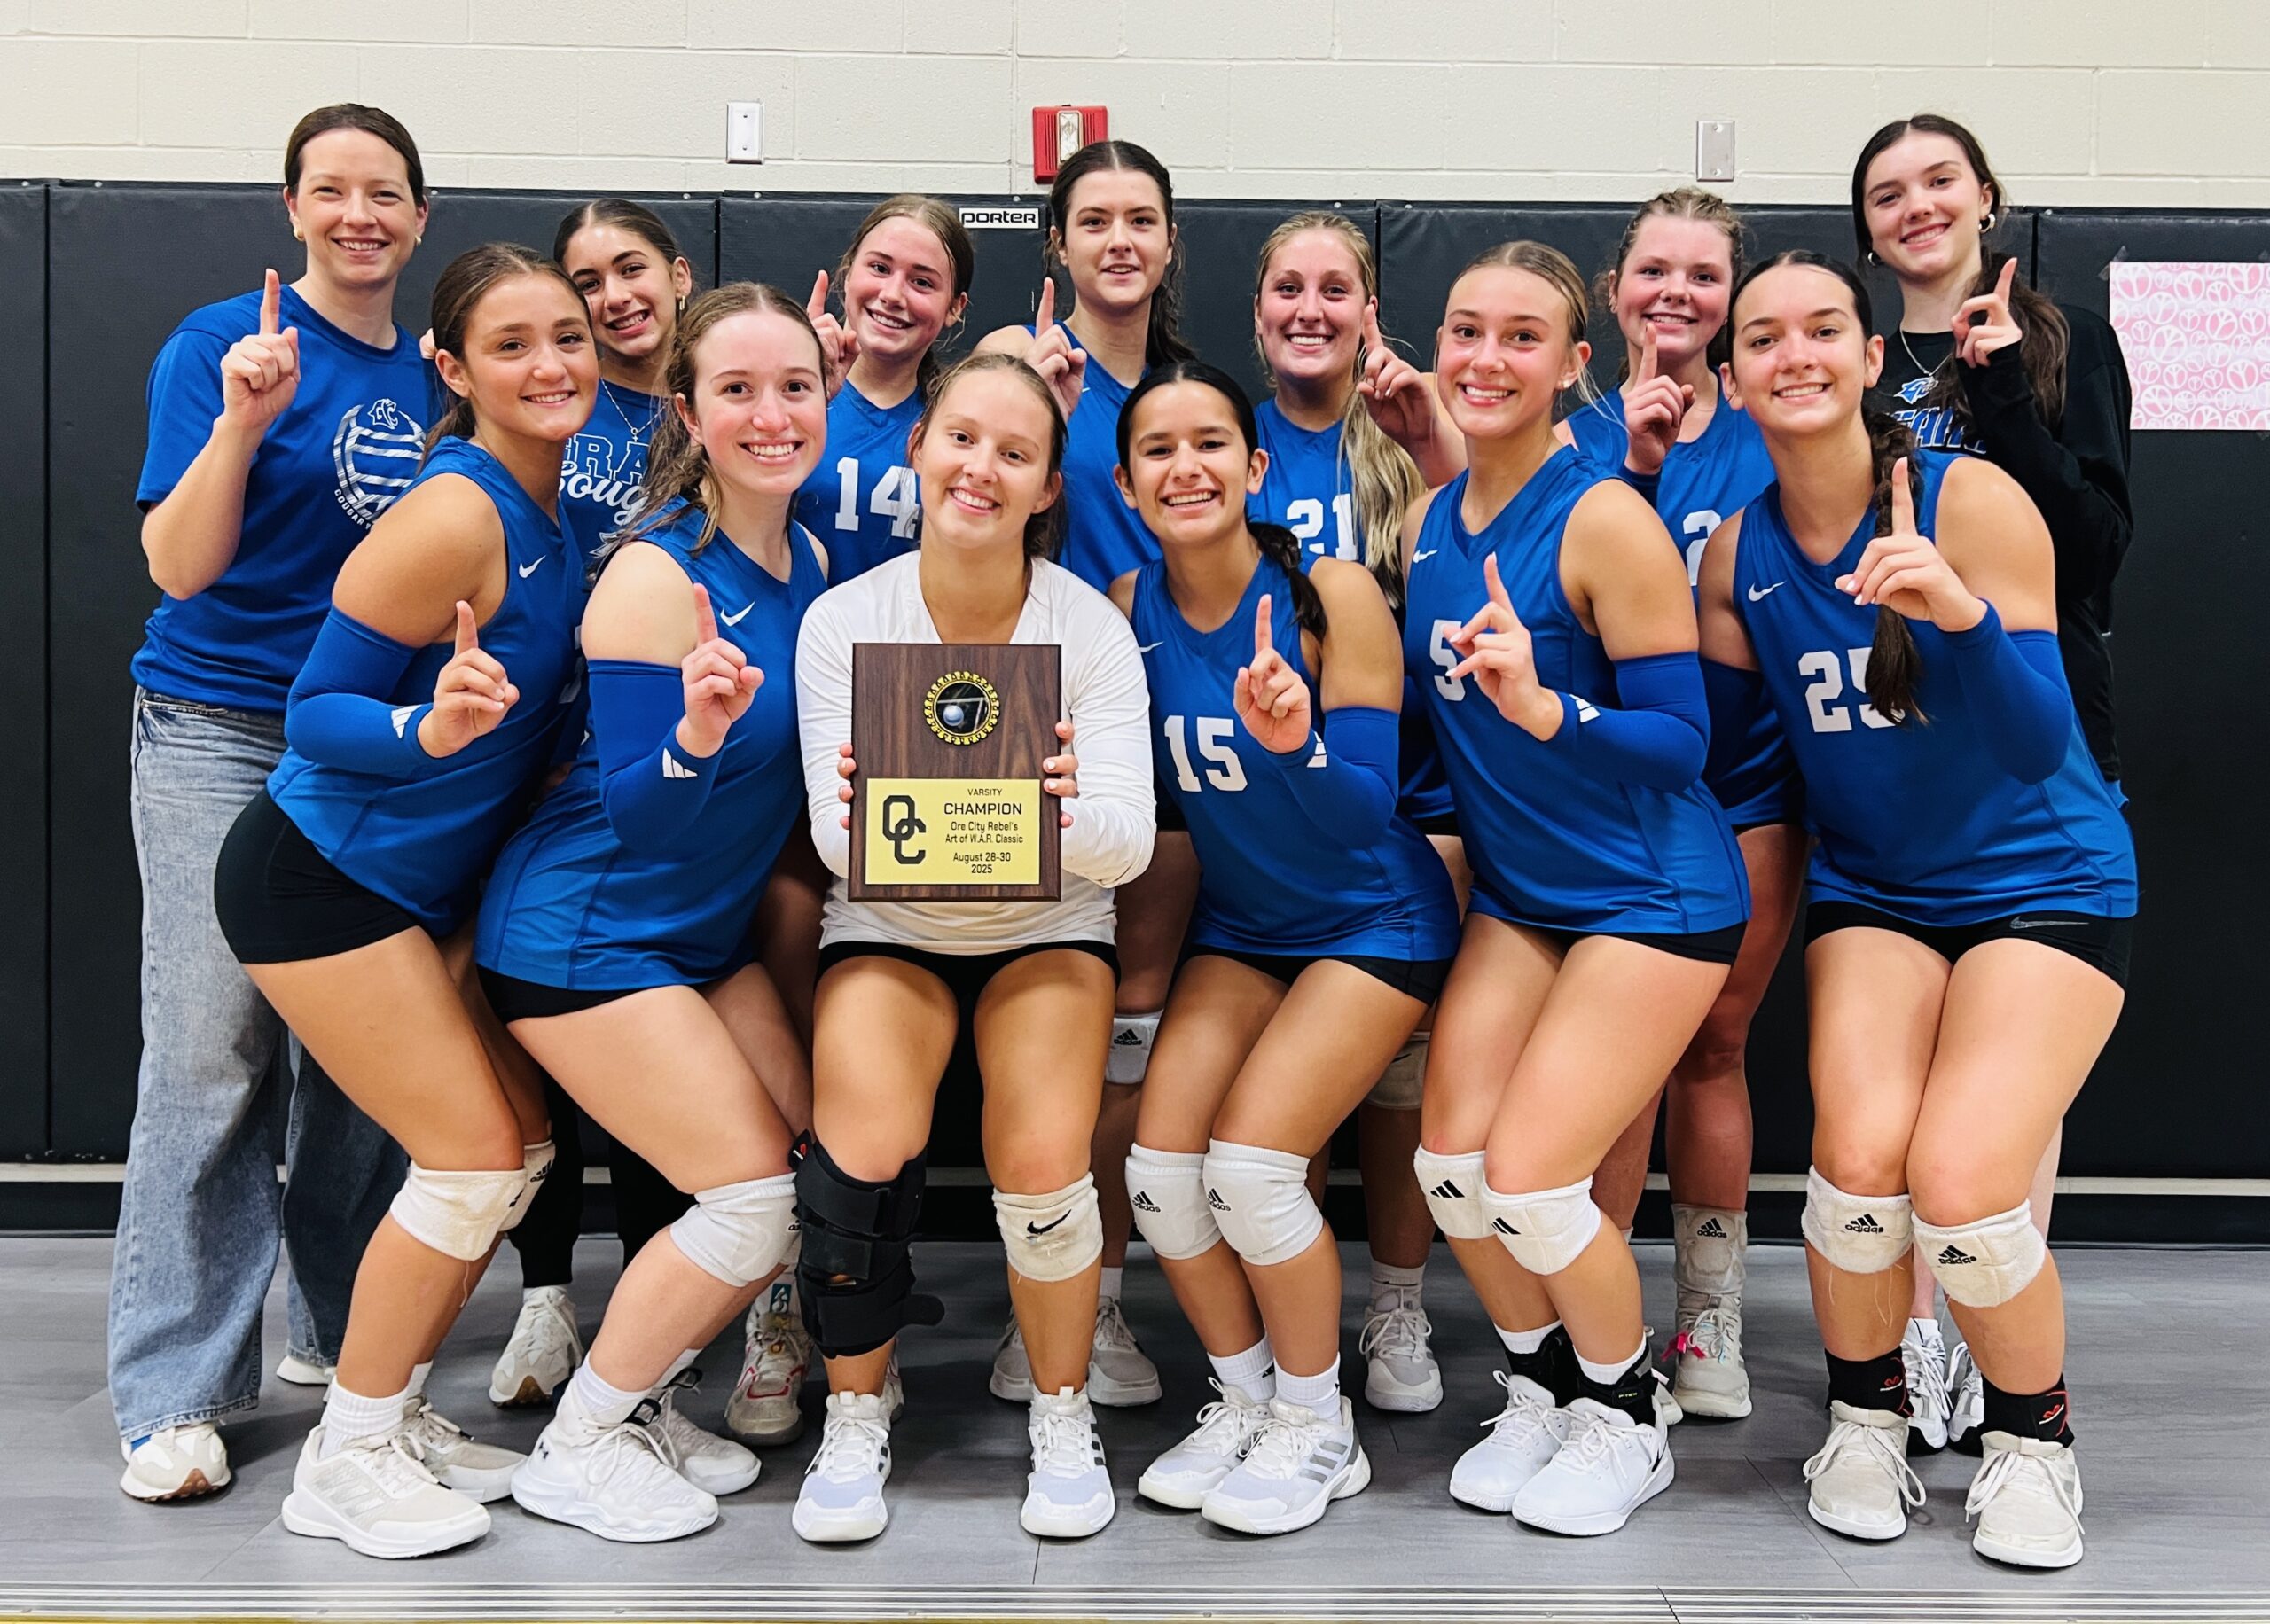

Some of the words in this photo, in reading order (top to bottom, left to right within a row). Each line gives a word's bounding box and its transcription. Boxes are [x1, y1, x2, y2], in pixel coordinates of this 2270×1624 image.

[961, 211, 1036, 225] porter
[835, 457, 920, 539] 14
[334, 488, 364, 526] COUGAR
[1287, 493, 1358, 561] 21
[1429, 619, 1466, 701] 5
[1164, 715, 1248, 792] 15
[943, 802, 1022, 816] CHAMPION
[951, 821, 967, 831] Ore
[968, 821, 986, 833] City
[988, 821, 1019, 832] Rebel's
[945, 833, 958, 843] Art
[959, 833, 968, 843] of
[970, 833, 994, 843] W.A.R.
[995, 833, 1023, 844] Classic
[953, 852, 983, 864] August
[985, 852, 1012, 862] 28-30
[971, 864, 993, 874] 2025
